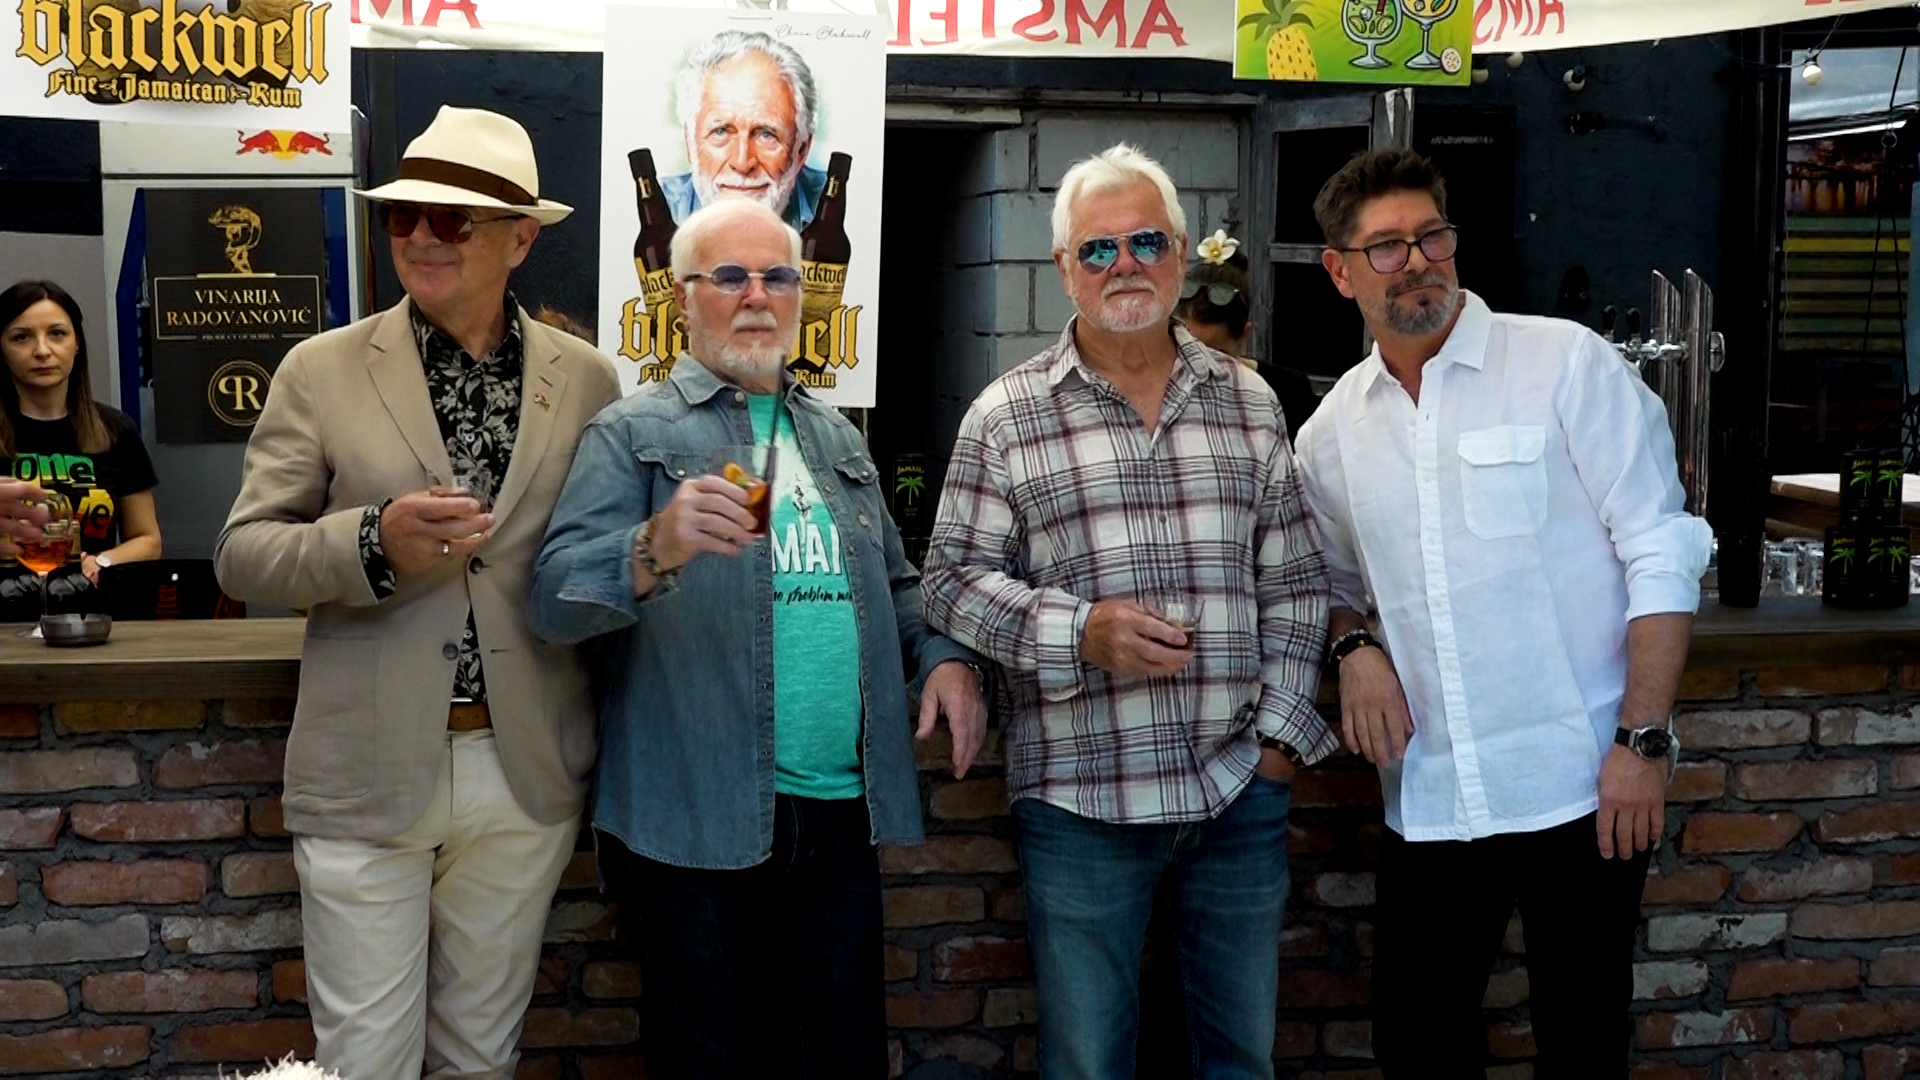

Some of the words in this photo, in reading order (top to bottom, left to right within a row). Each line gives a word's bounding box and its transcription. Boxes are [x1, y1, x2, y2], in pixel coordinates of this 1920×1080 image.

[15, 0, 333, 85] blackwell
[45, 68, 99, 98] Fine
[118, 73, 228, 104] Jamaican
[247, 81, 303, 109] Rum
